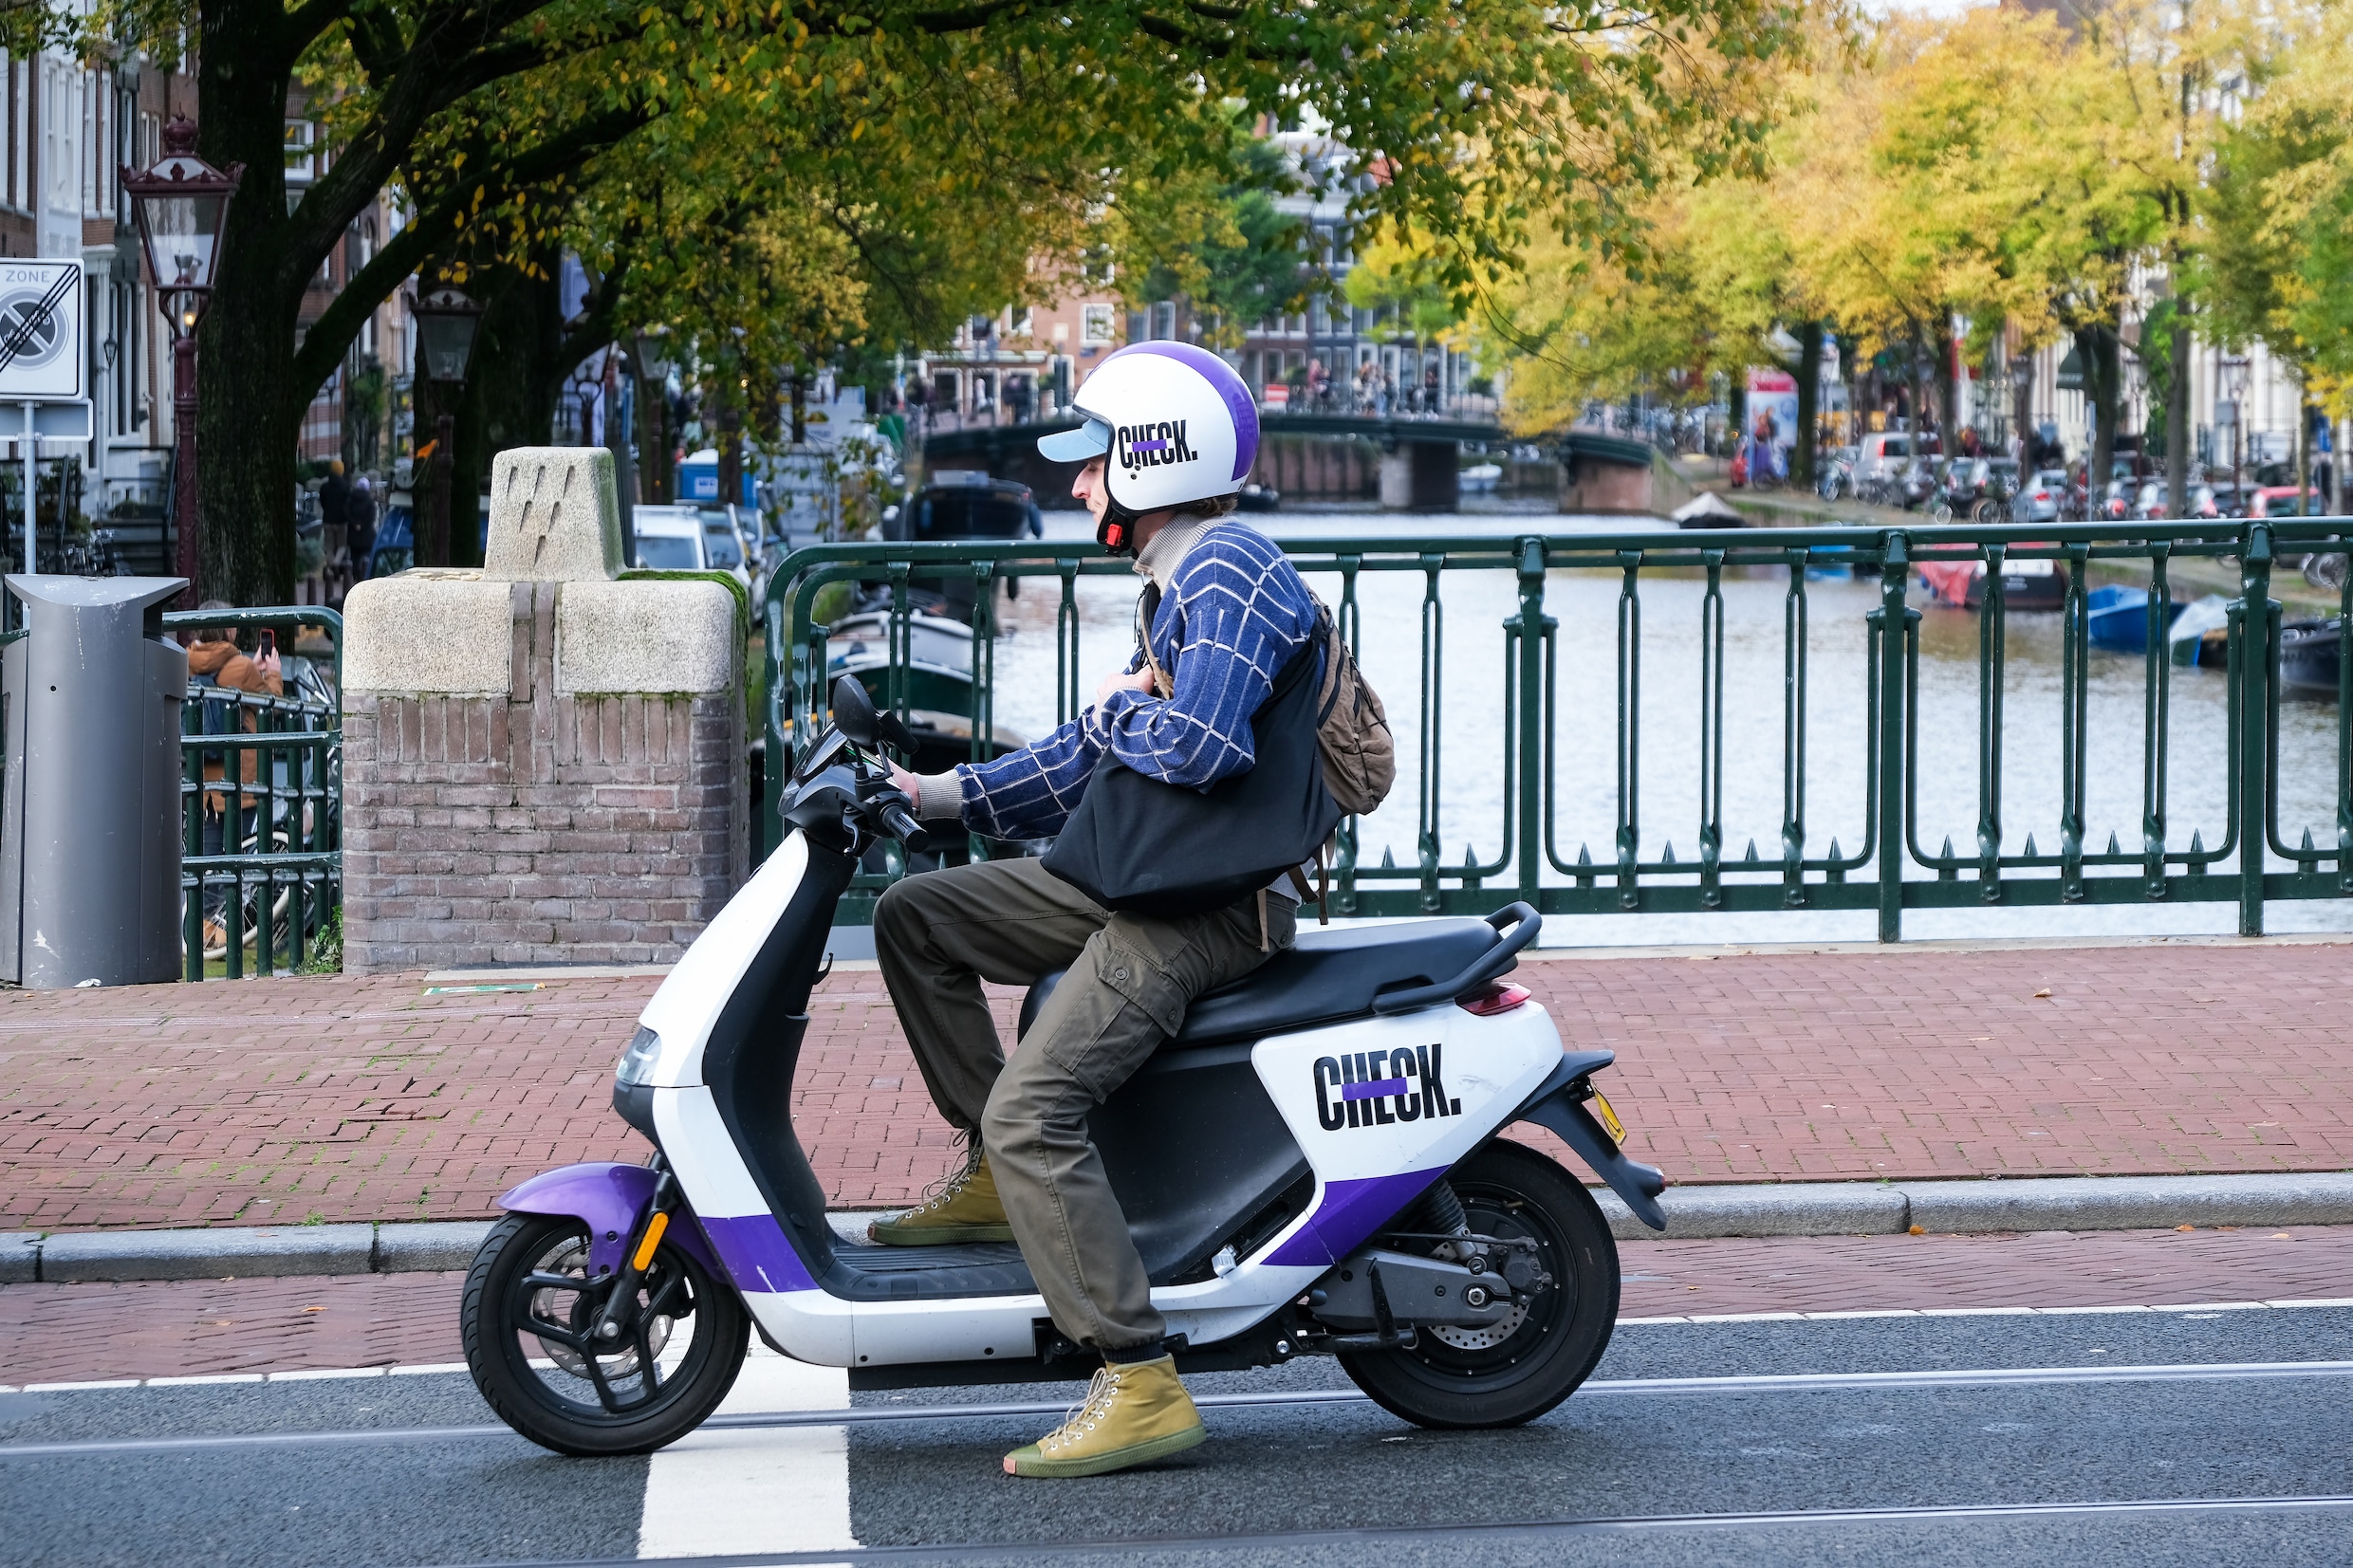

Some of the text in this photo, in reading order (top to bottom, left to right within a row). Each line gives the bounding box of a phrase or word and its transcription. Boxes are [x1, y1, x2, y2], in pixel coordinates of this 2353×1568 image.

[6, 269, 51, 283] ZONE
[1118, 419, 1198, 469] CHECK.
[1312, 1043, 1462, 1131] CHECK.
